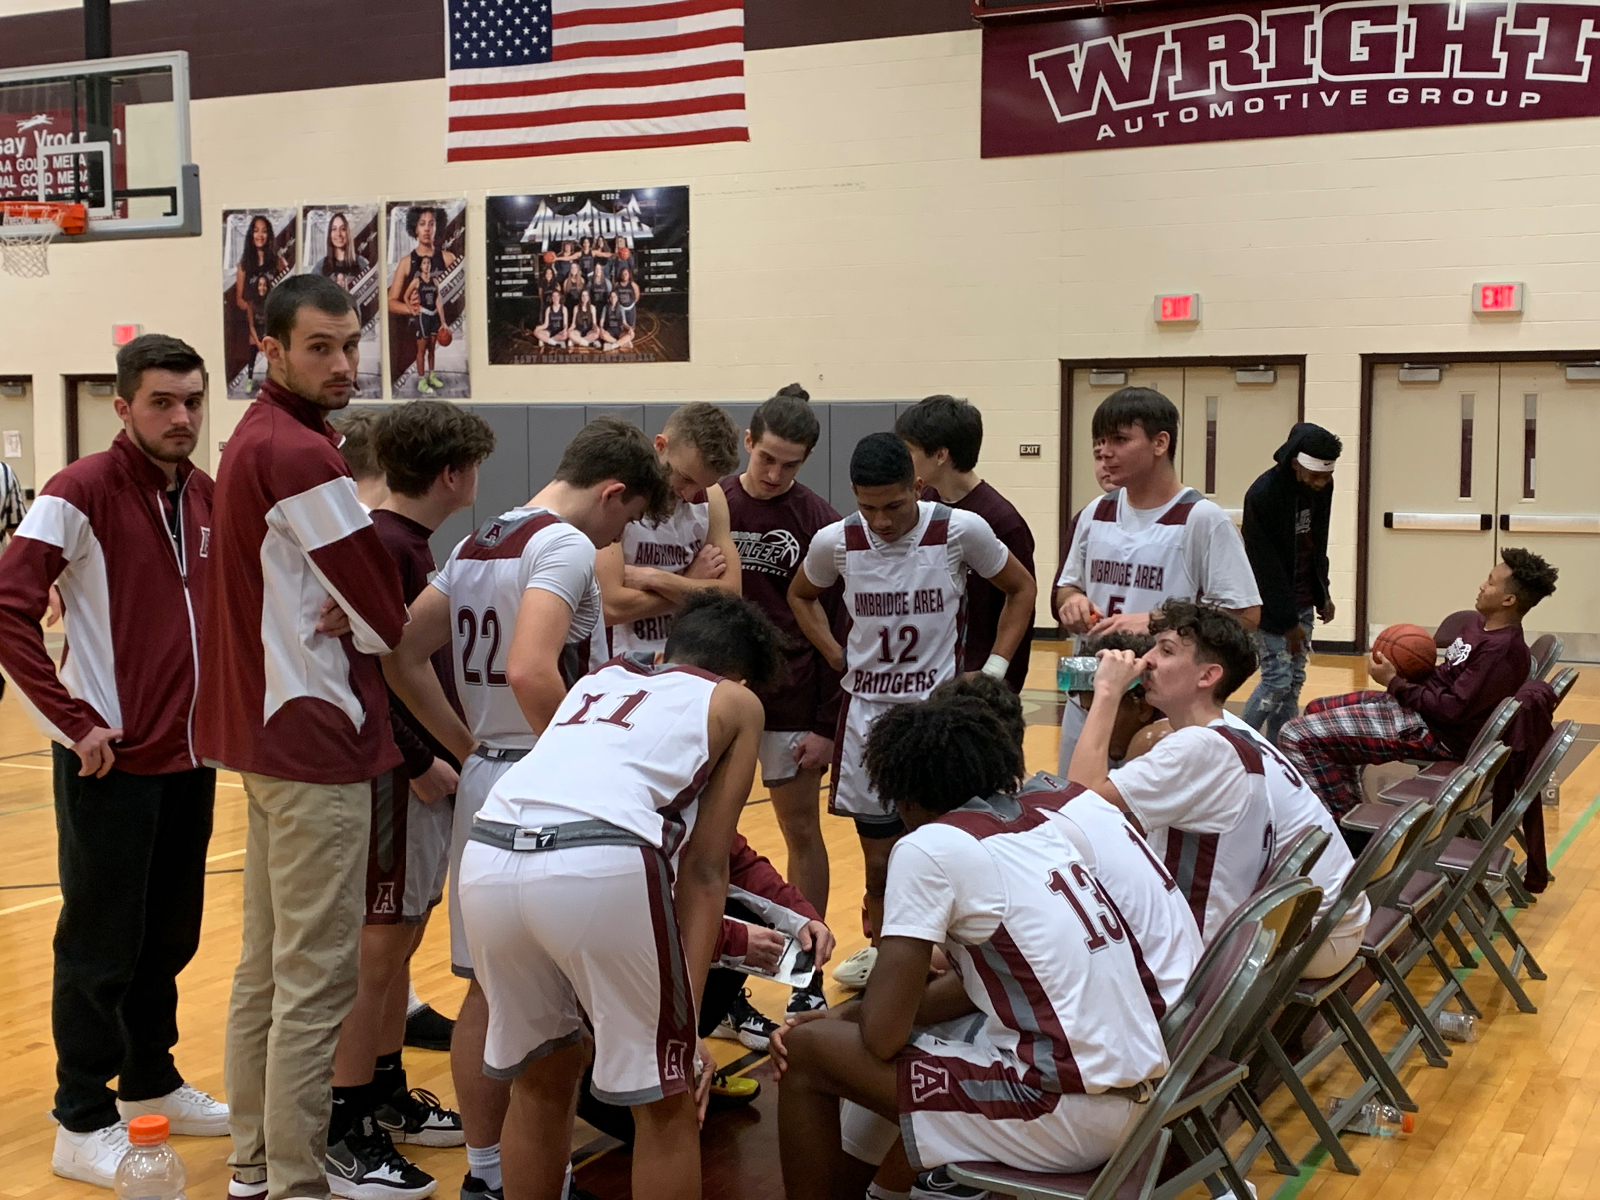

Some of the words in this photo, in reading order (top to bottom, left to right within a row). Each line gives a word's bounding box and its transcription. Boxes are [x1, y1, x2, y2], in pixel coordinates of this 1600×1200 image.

[1028, 0, 1600, 122] WRIGHT
[1096, 89, 1368, 140] AUTOMOTIVE
[1388, 87, 1541, 108] GROUP
[21, 171, 53, 187] GOD
[520, 193, 654, 252] AMBRIDGE
[1161, 295, 1193, 320] EXIT
[1481, 284, 1517, 311] EXIT
[1020, 445, 1040, 454] EXIT
[485, 523, 503, 542] A
[634, 541, 689, 566] AMBRIDGE
[742, 564, 788, 577] SKETBALL
[1133, 563, 1164, 591] AREA
[854, 591, 910, 617] AMBRIDGE
[913, 588, 944, 614] AREA
[458, 605, 510, 687] 22
[878, 624, 919, 664] 12
[853, 669, 938, 694] BRIDGERS
[373, 882, 397, 914] A
[1045, 861, 1125, 954] 13
[664, 1039, 688, 1081] A
[911, 1061, 949, 1103] A
